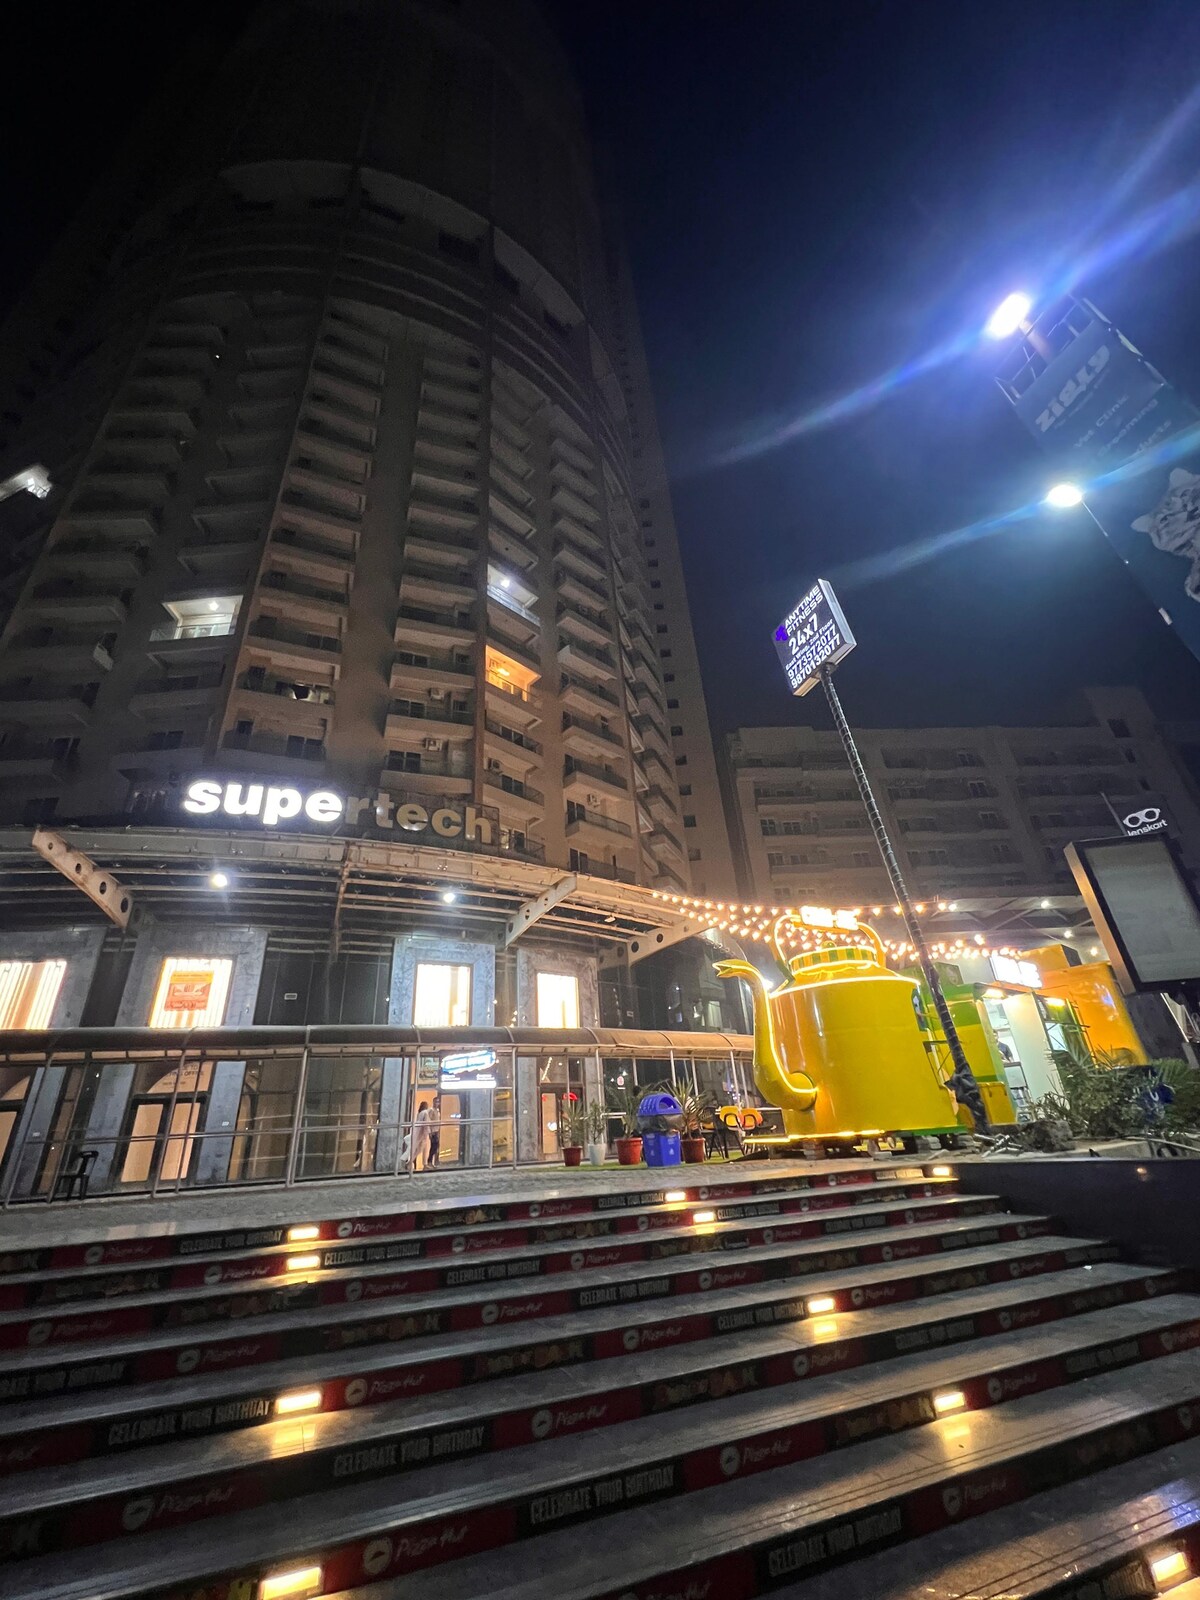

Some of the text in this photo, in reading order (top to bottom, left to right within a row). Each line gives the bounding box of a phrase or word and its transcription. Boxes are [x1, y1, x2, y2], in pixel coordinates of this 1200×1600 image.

[785, 585, 821, 629] ANYTIME
[787, 592, 824, 637] FITNESS
[819, 619, 833, 635] Floor
[788, 624, 836, 679] 9773572077
[789, 613, 818, 656] 24x7
[791, 633, 840, 689] 9870132077
[184, 780, 493, 844] supertech
[1127, 819, 1168, 836] lenskart
[446, 1259, 541, 1285] CELEBRATE YOUR BIRTHDAY
[332, 1425, 485, 1479] CELEBRATE YOUR BIRTHDAY
[529, 1464, 675, 1525] CELEBRATE YOUR BIRTHDAY
